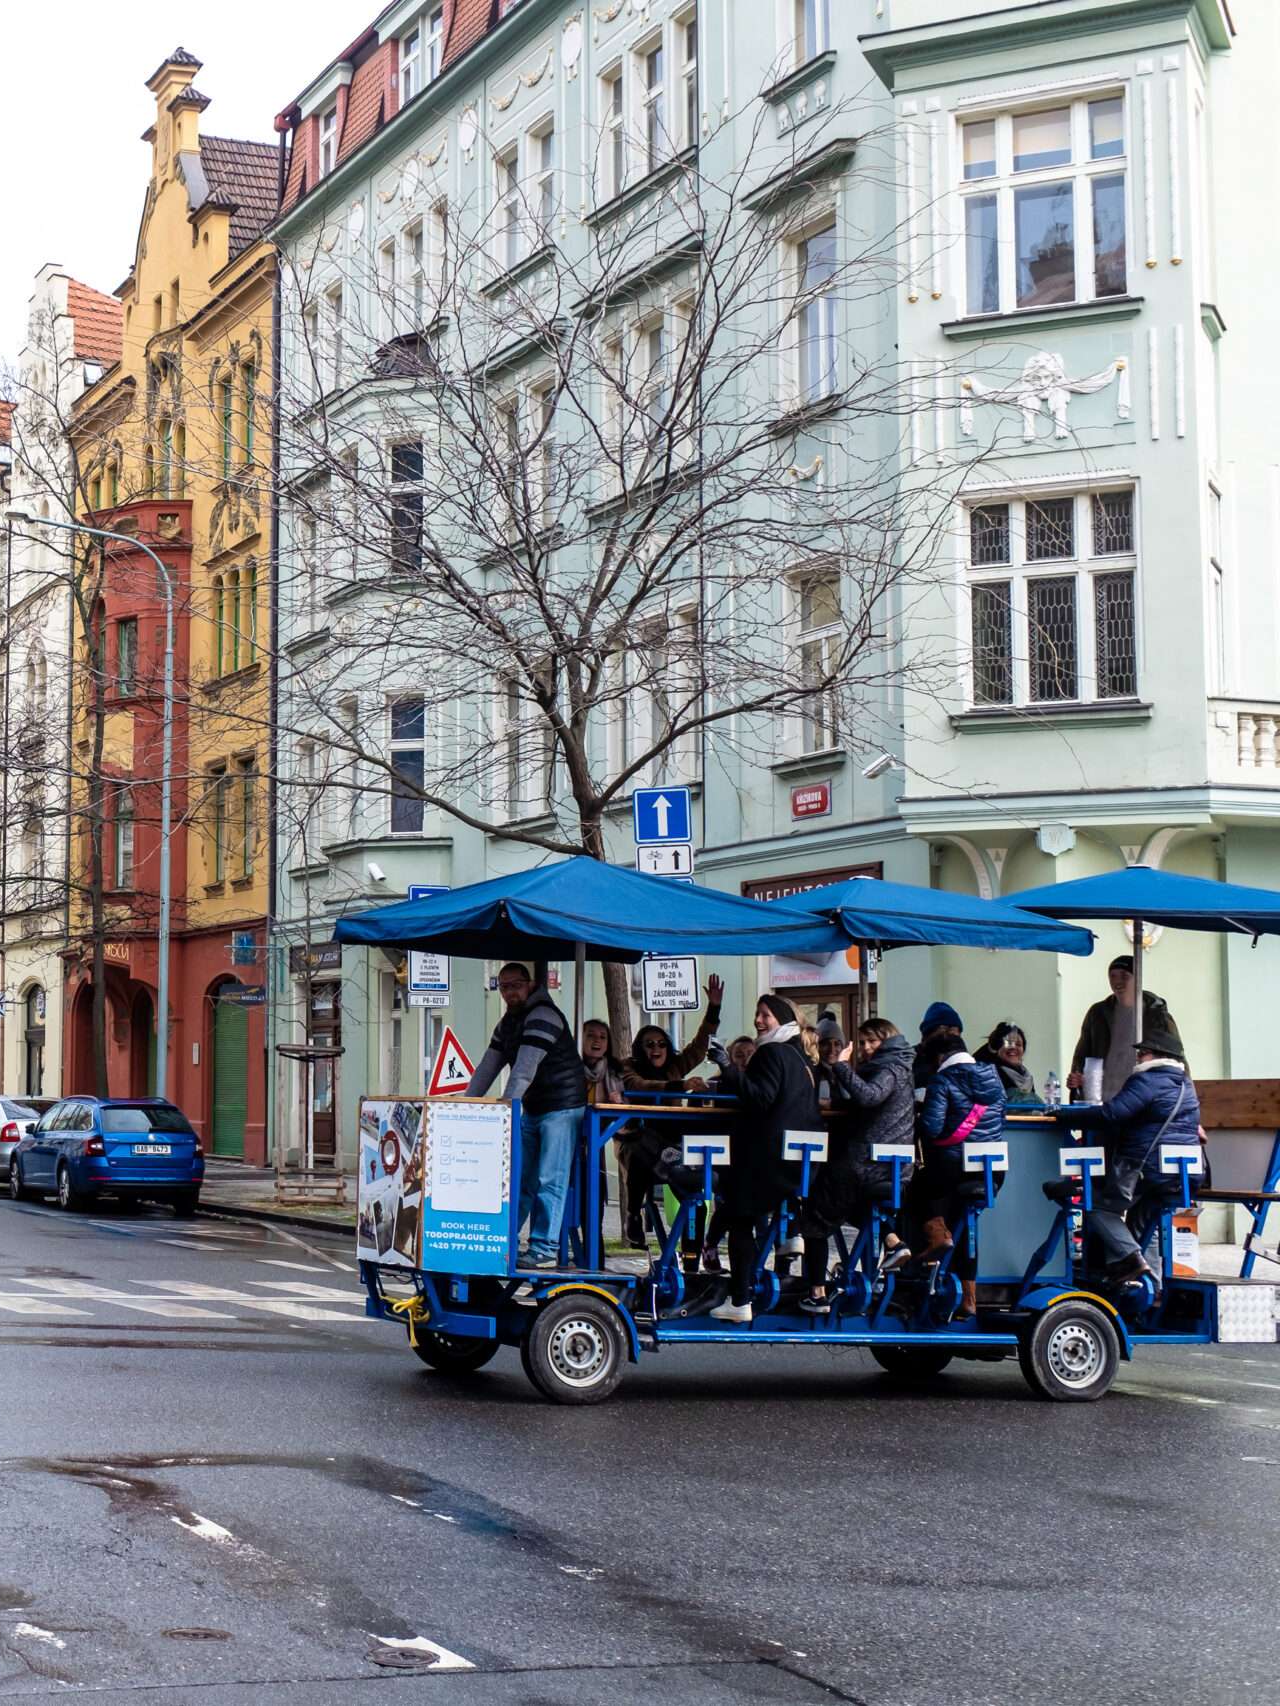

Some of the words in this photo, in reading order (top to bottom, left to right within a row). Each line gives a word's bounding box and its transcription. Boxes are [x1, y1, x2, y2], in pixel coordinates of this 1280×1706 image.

[441, 1222, 465, 1231] BOOK
[467, 1223, 491, 1232] HERE
[425, 1231, 508, 1243] TODOPRAGUE.COM
[428, 1242, 449, 1250] +420
[451, 1243, 467, 1251] 777
